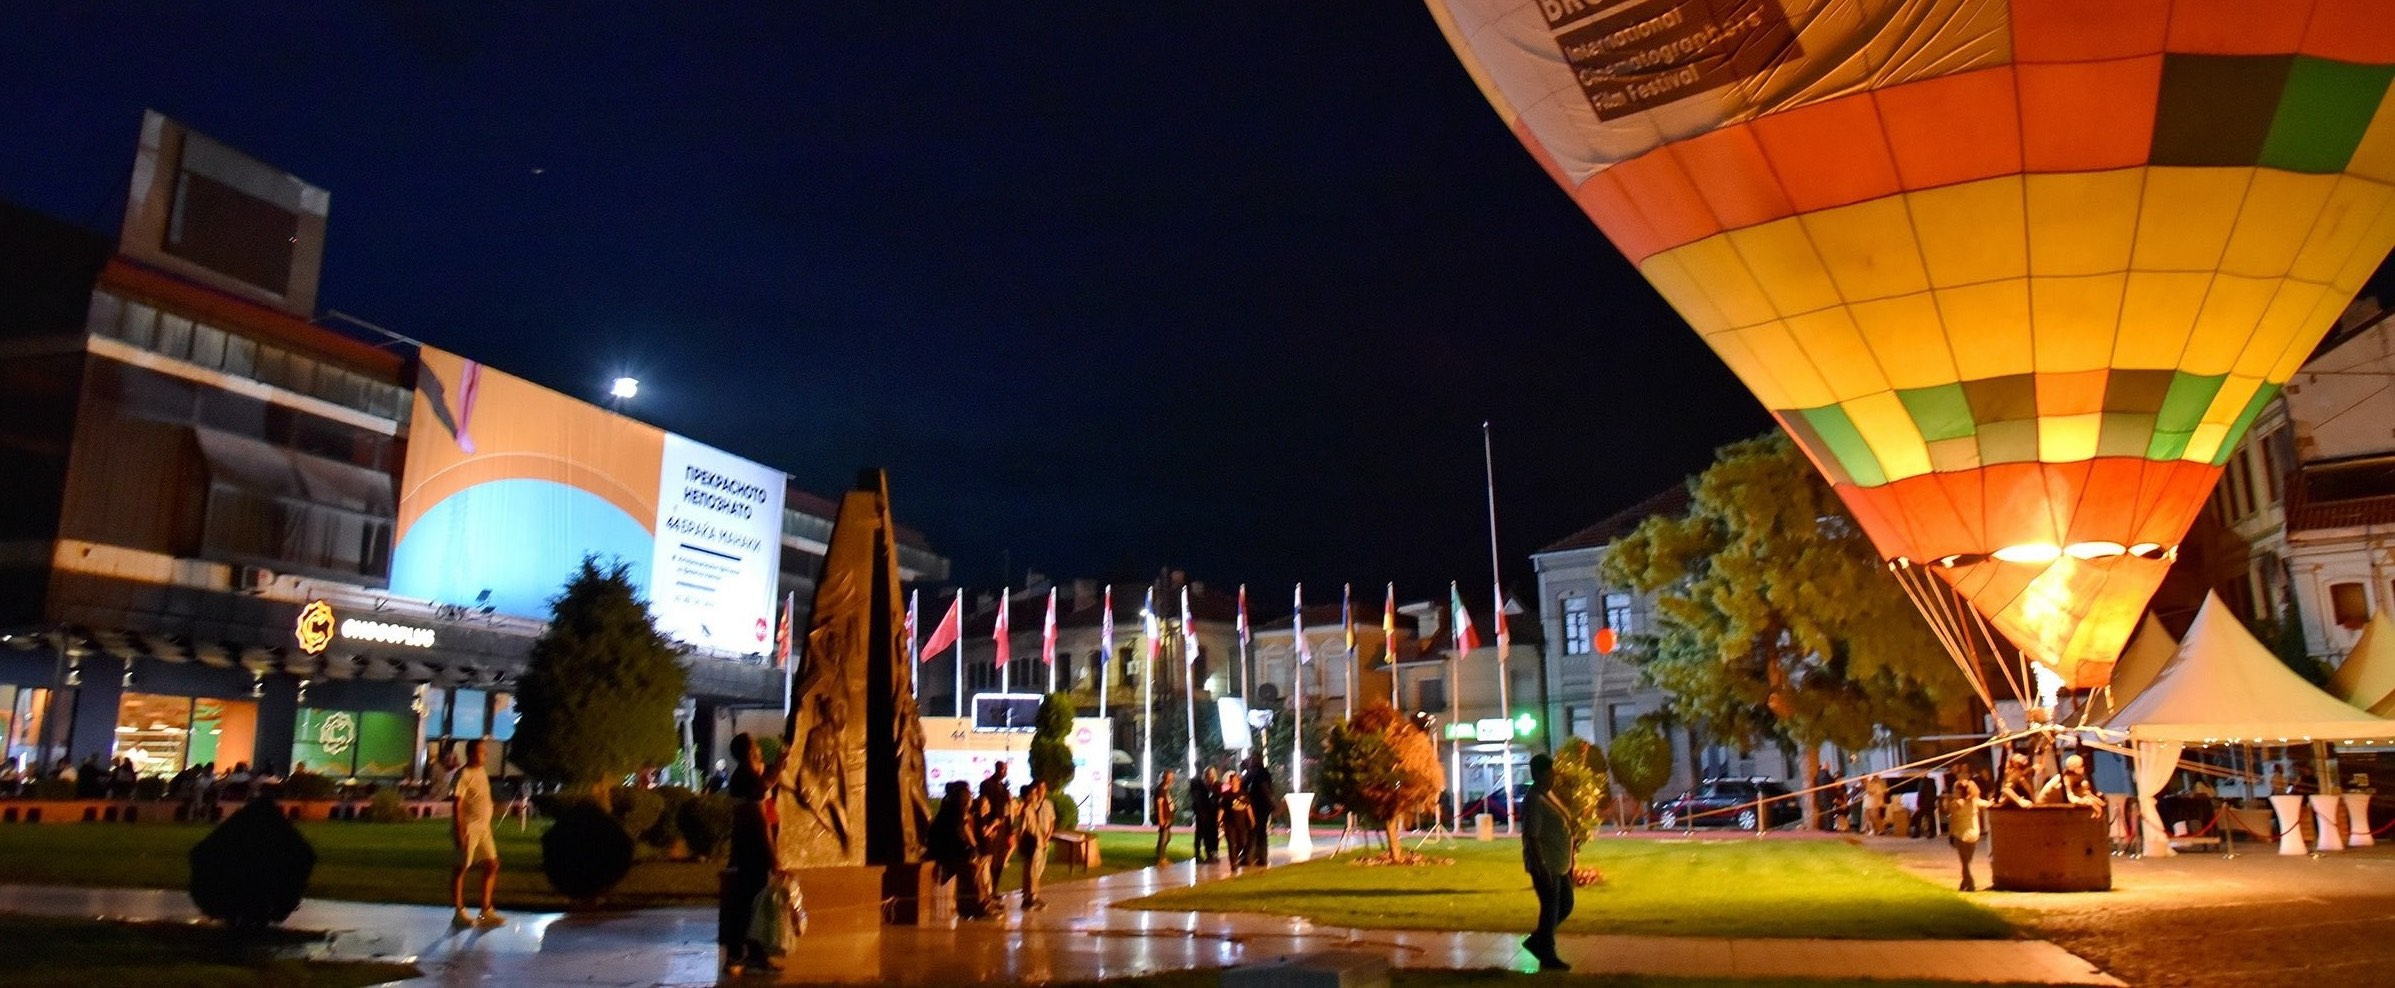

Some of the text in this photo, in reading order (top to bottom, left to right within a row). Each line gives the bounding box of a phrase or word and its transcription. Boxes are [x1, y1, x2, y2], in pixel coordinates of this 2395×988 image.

[1565, 7, 1681, 62] International
[1626, 63, 1700, 102] Festival
[683, 486, 753, 521] НЕПОЗНАТО
[684, 464, 768, 505] ПРЕКРАСНОТО
